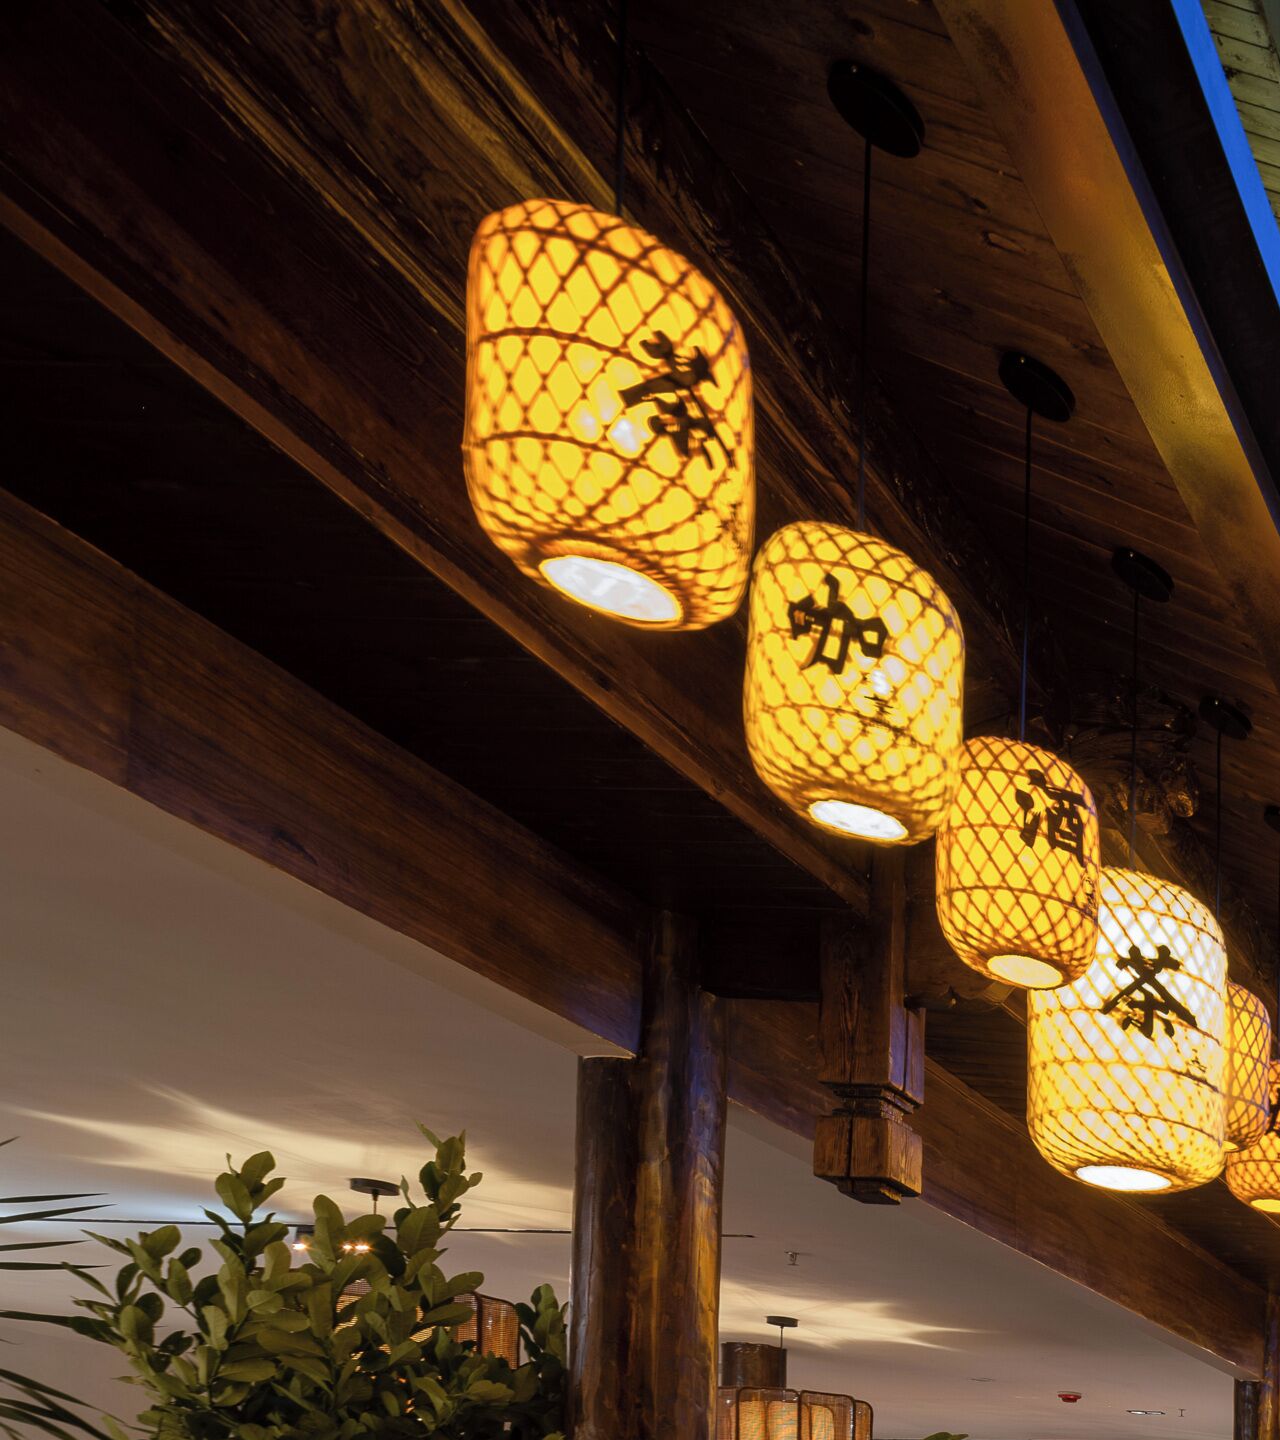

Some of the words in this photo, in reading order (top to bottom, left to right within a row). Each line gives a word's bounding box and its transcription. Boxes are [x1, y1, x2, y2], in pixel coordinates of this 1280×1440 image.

[788, 573, 889, 675] 咖
[1014, 768, 1086, 867] 酒
[1099, 944, 1199, 1041] 茶
